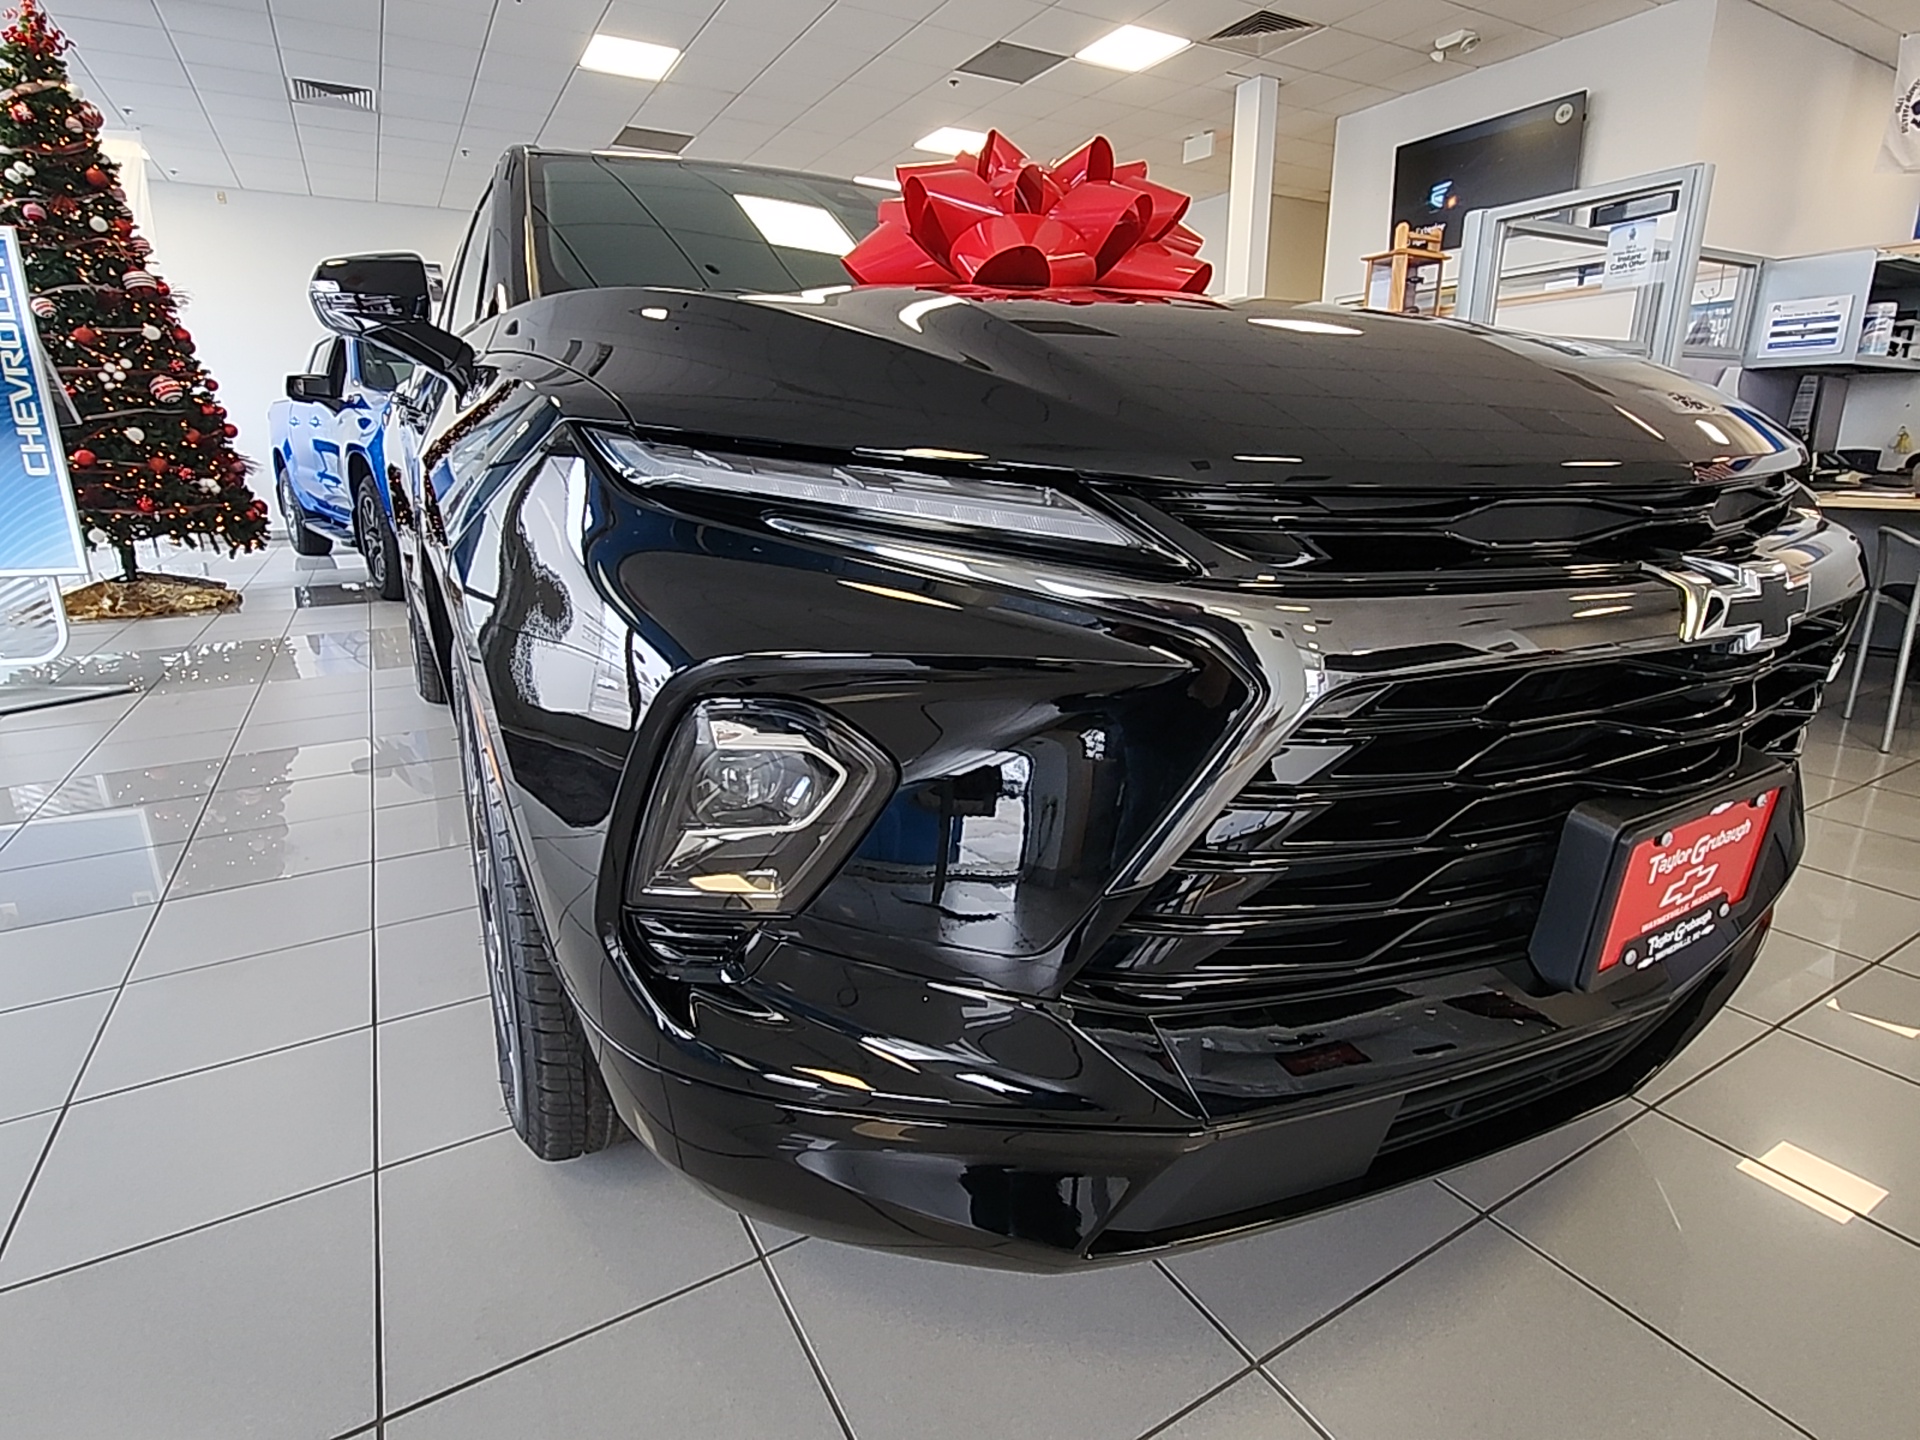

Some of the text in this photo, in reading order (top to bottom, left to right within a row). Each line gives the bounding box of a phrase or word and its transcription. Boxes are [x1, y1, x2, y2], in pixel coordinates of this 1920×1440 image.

[0, 257, 51, 476] CHEVROL
[1648, 818, 1752, 884] Taylor Grubaugh
